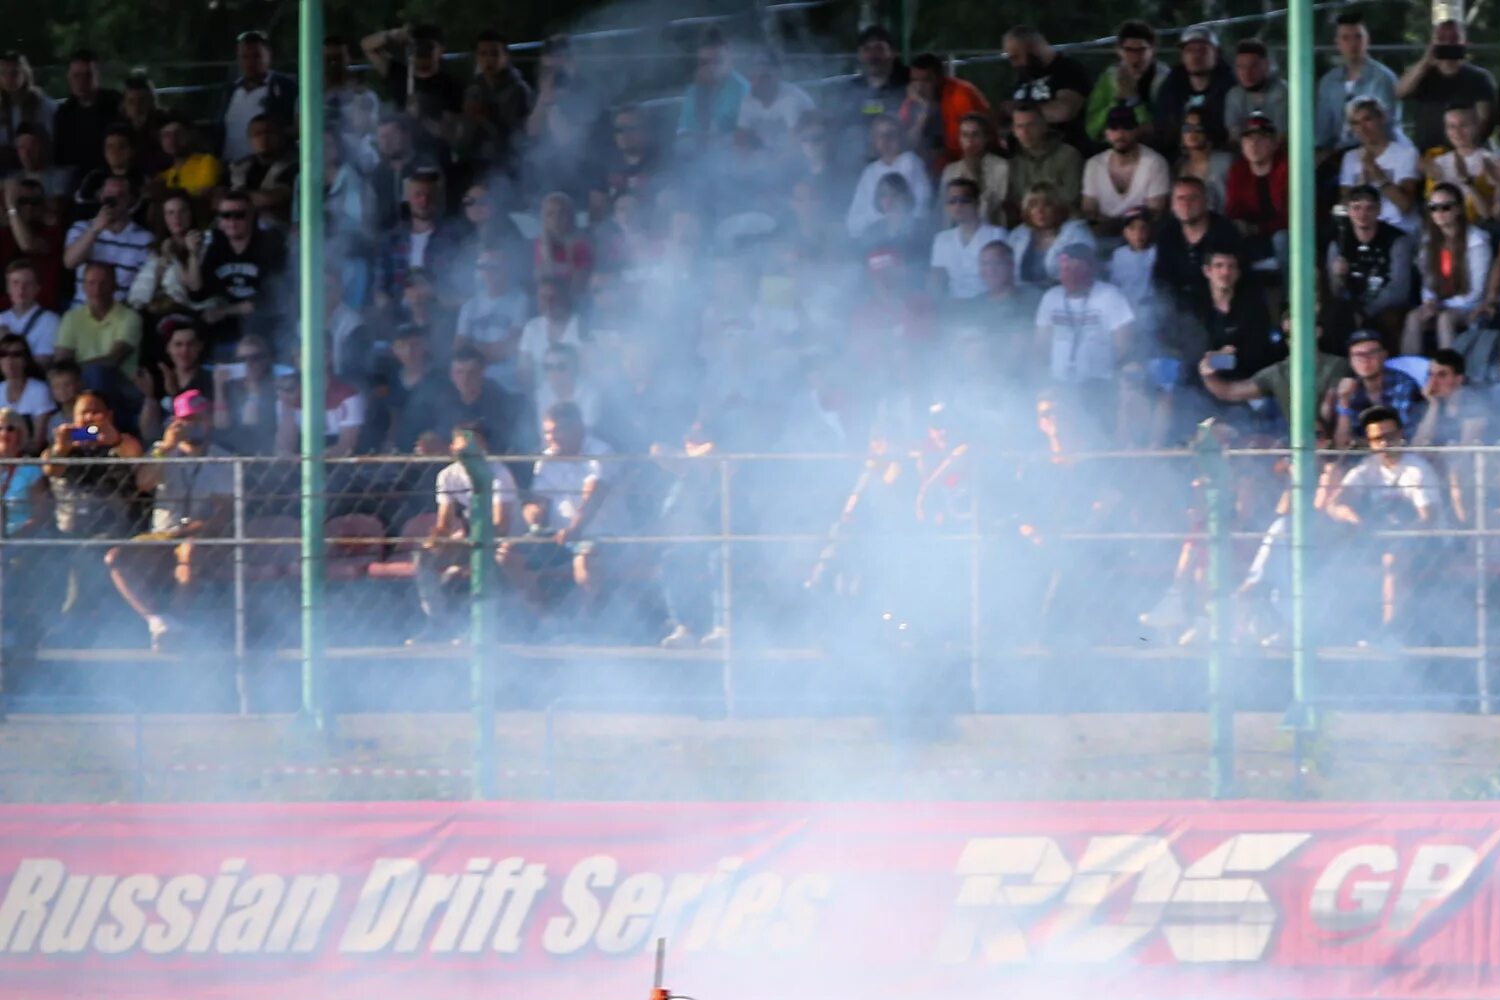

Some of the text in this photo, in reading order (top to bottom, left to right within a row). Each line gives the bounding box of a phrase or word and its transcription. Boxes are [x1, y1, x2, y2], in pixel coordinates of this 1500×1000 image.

[0, 855, 832, 955] Russian Drift Series
[936, 833, 1481, 963] RDS GP
